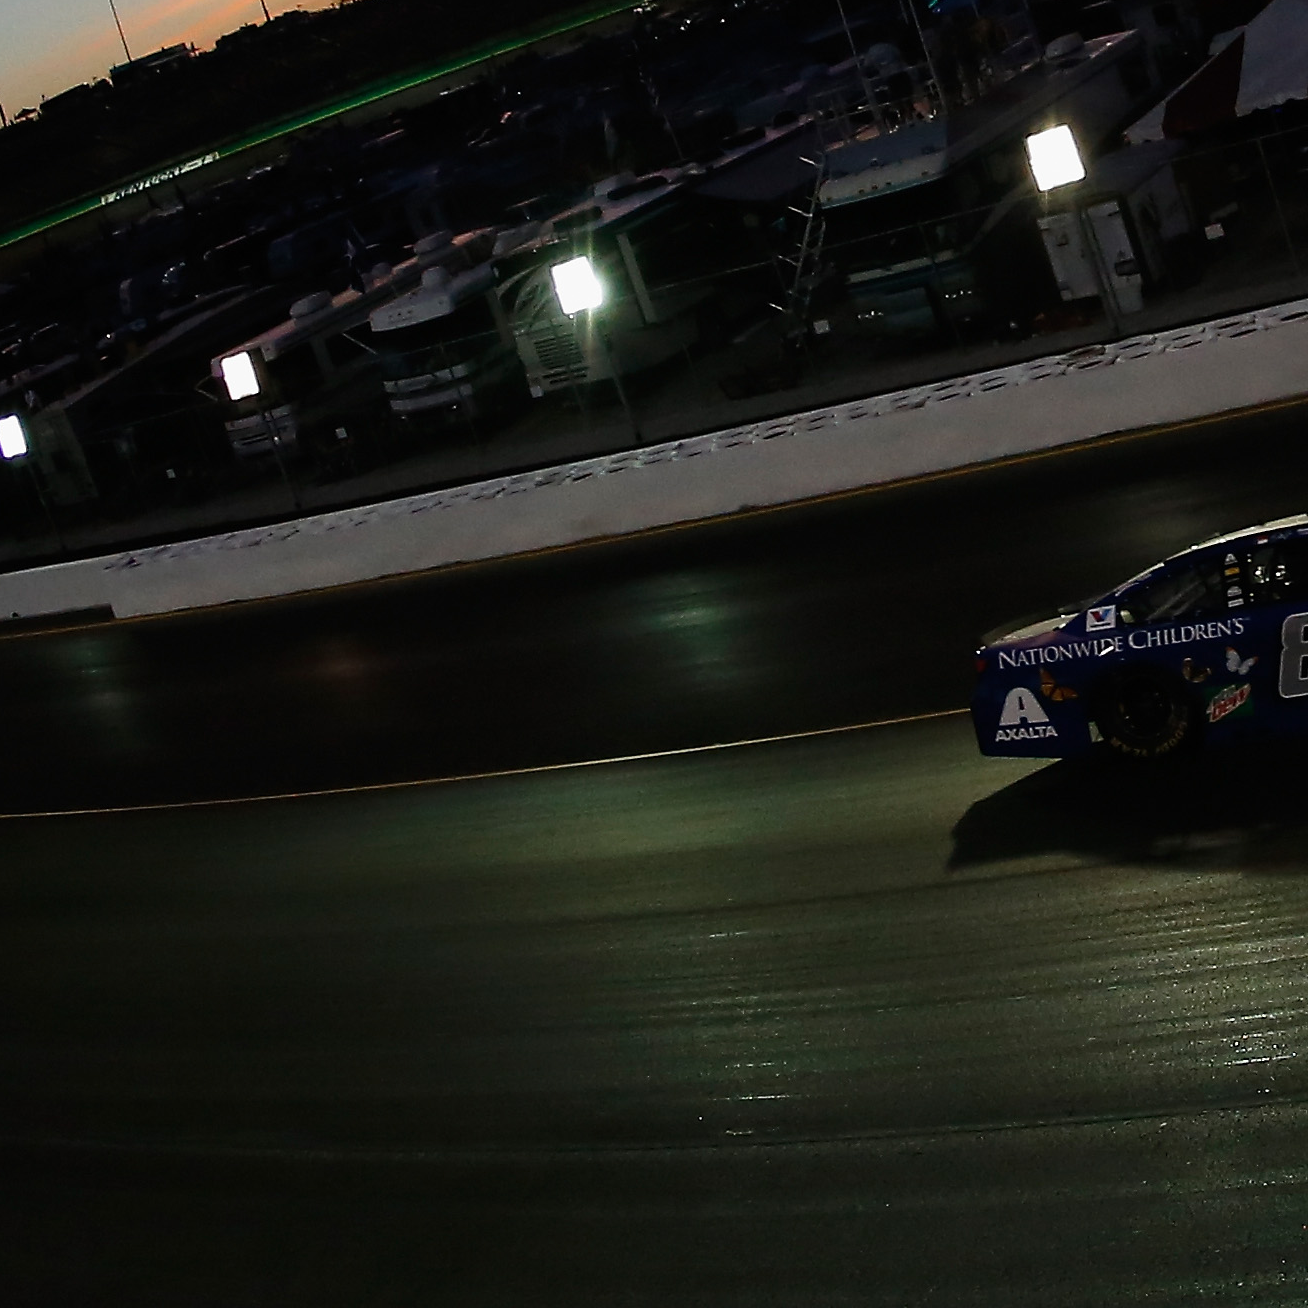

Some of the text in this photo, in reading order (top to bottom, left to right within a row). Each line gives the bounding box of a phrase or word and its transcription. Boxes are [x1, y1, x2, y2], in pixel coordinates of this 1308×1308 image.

[997, 618, 1245, 670] NATIONWIDE CHILDREN'S
[995, 726, 1059, 742] AXALTA
